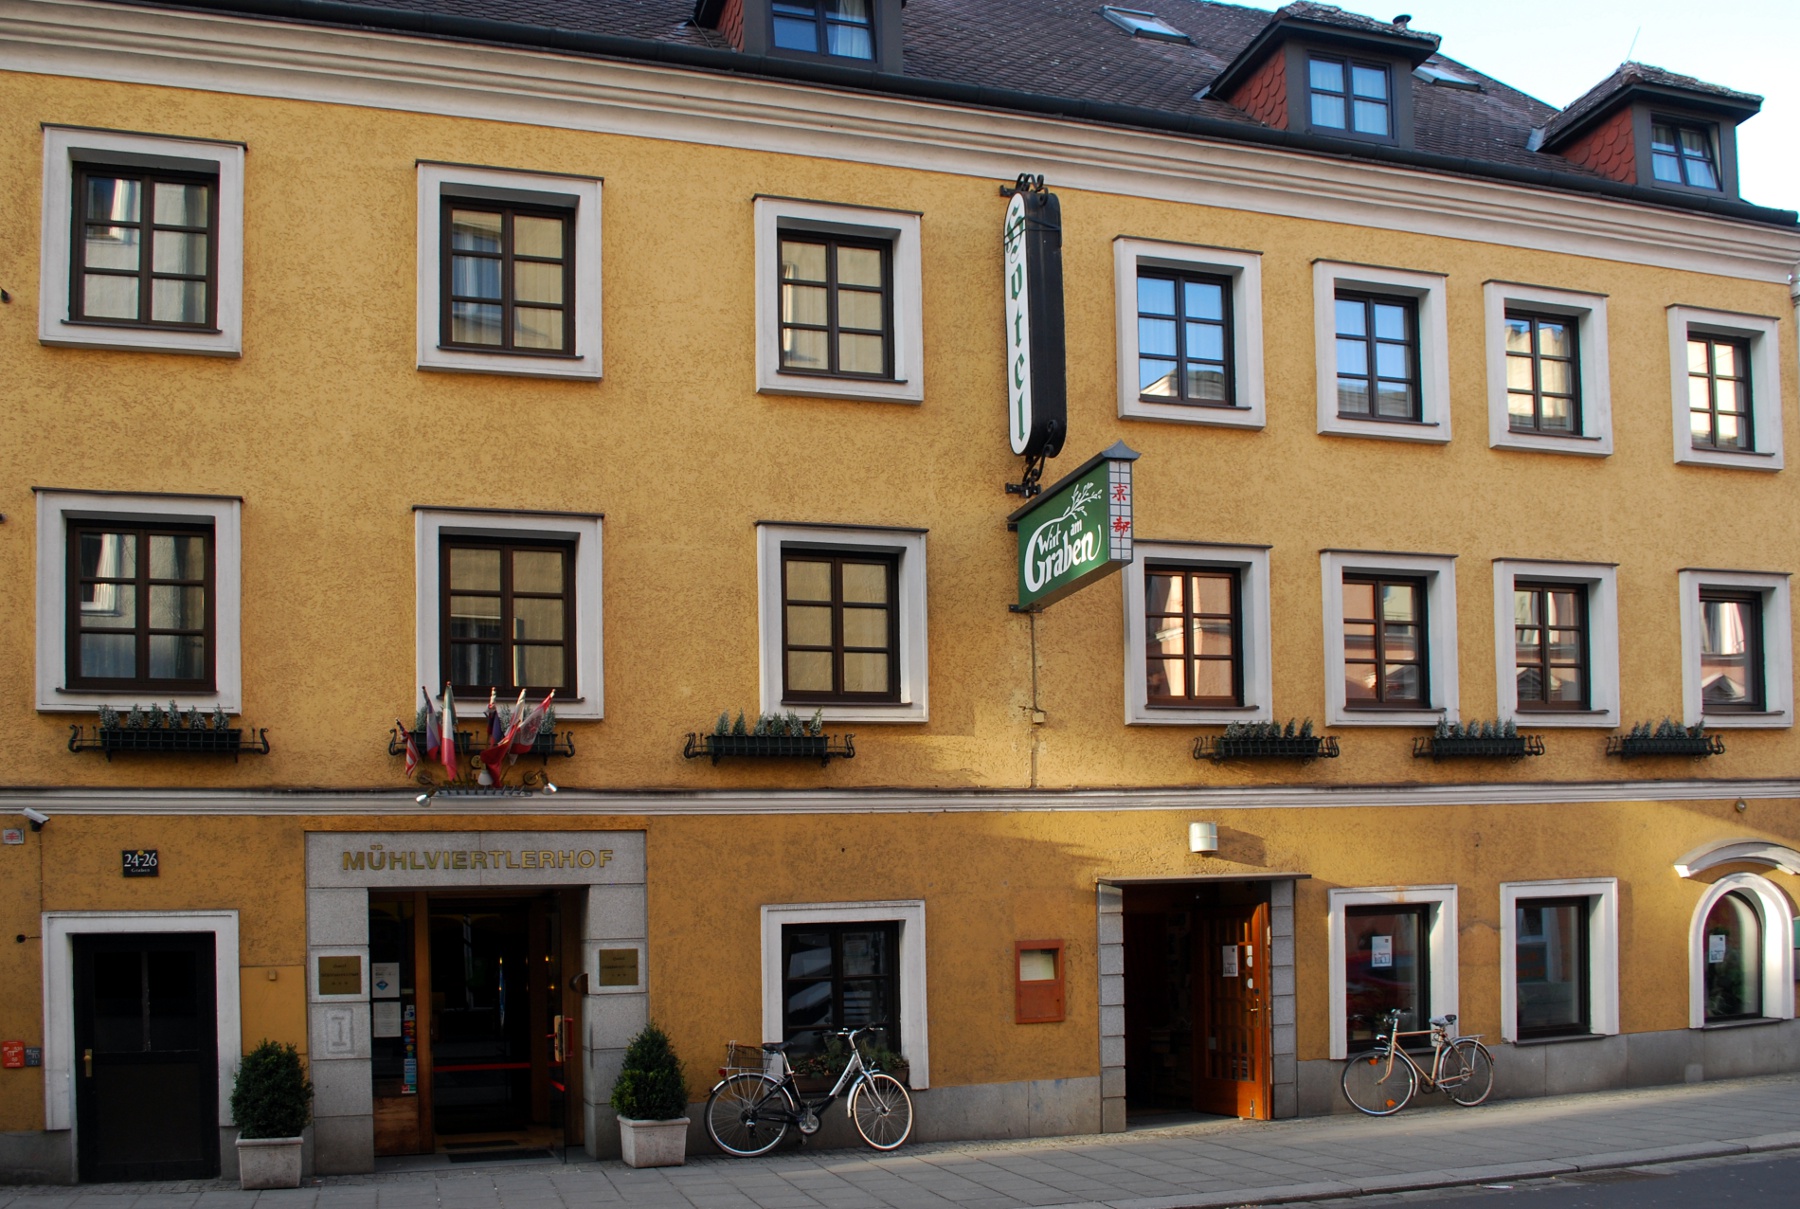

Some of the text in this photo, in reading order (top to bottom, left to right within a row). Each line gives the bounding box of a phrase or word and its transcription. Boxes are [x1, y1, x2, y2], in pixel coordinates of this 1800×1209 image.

[1005, 204, 1025, 443] Hotel
[1023, 517, 1102, 593] Graben
[1037, 519, 1083, 555] Wirt am
[123, 852, 158, 867] 24-26
[341, 844, 614, 871] MÜHLVIERTLERHOF
